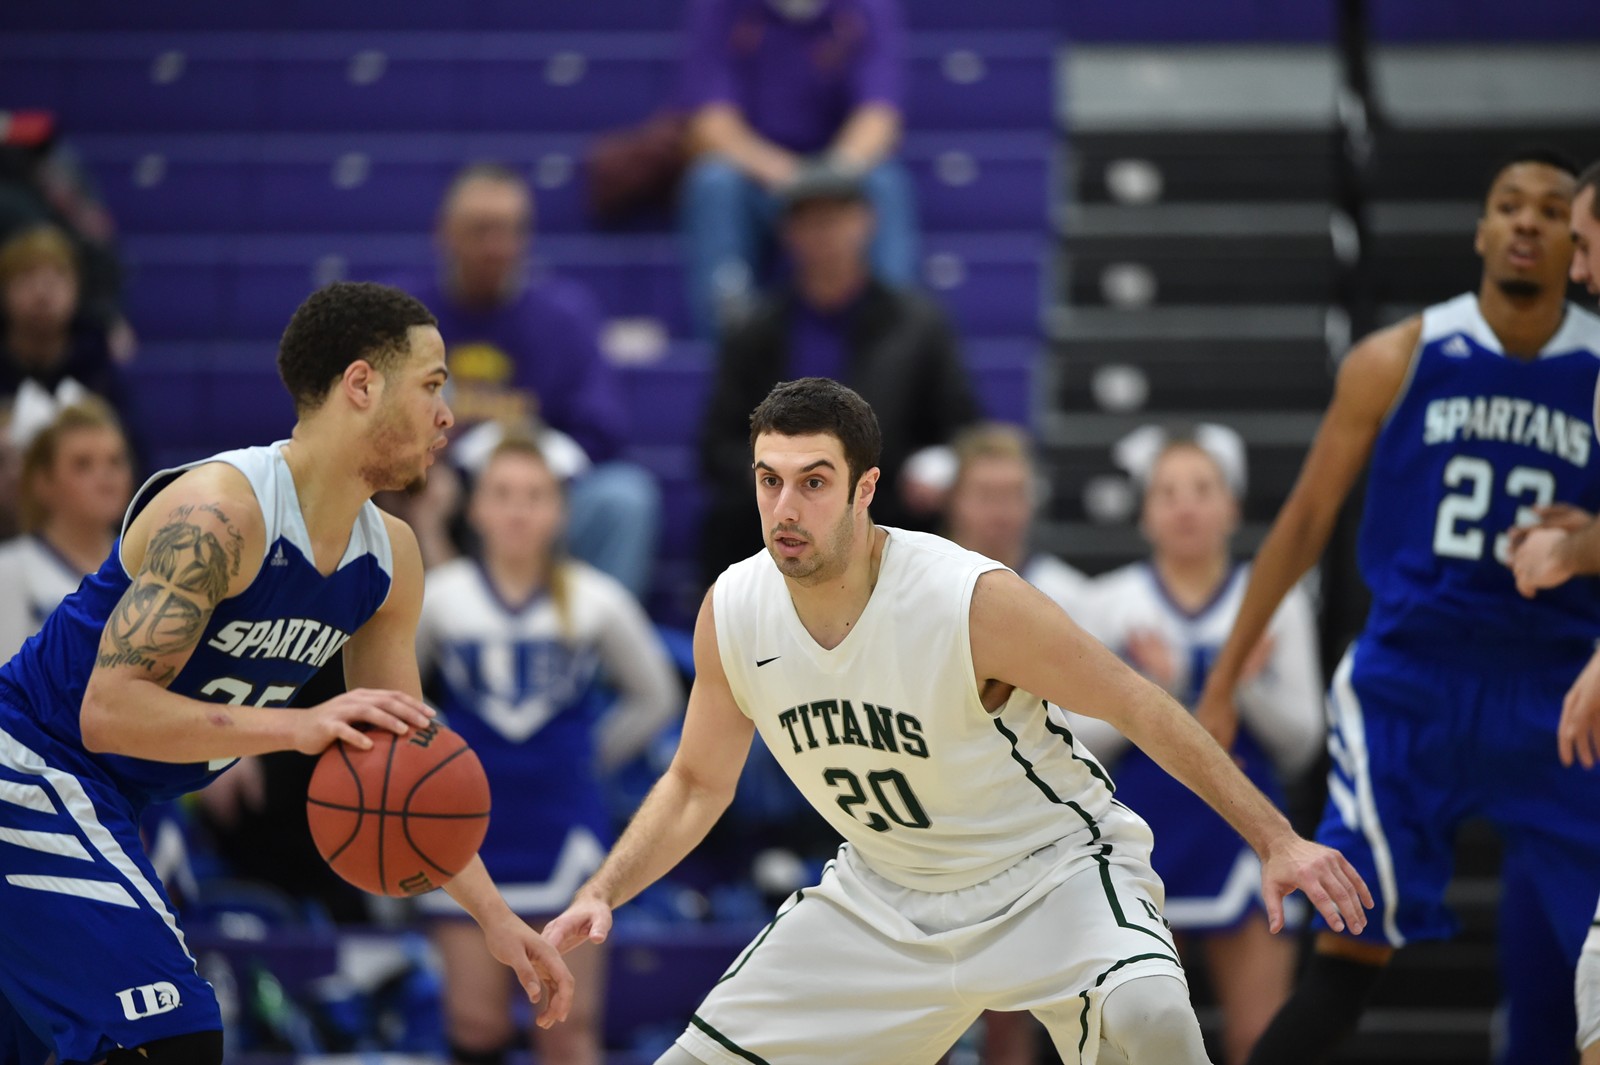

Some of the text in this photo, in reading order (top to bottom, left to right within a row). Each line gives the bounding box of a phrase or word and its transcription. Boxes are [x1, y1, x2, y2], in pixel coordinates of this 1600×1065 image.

[1423, 396, 1592, 468] SPARTANS
[1434, 454, 1556, 567] 23
[777, 699, 931, 760] TITANS
[822, 766, 934, 833] 20
